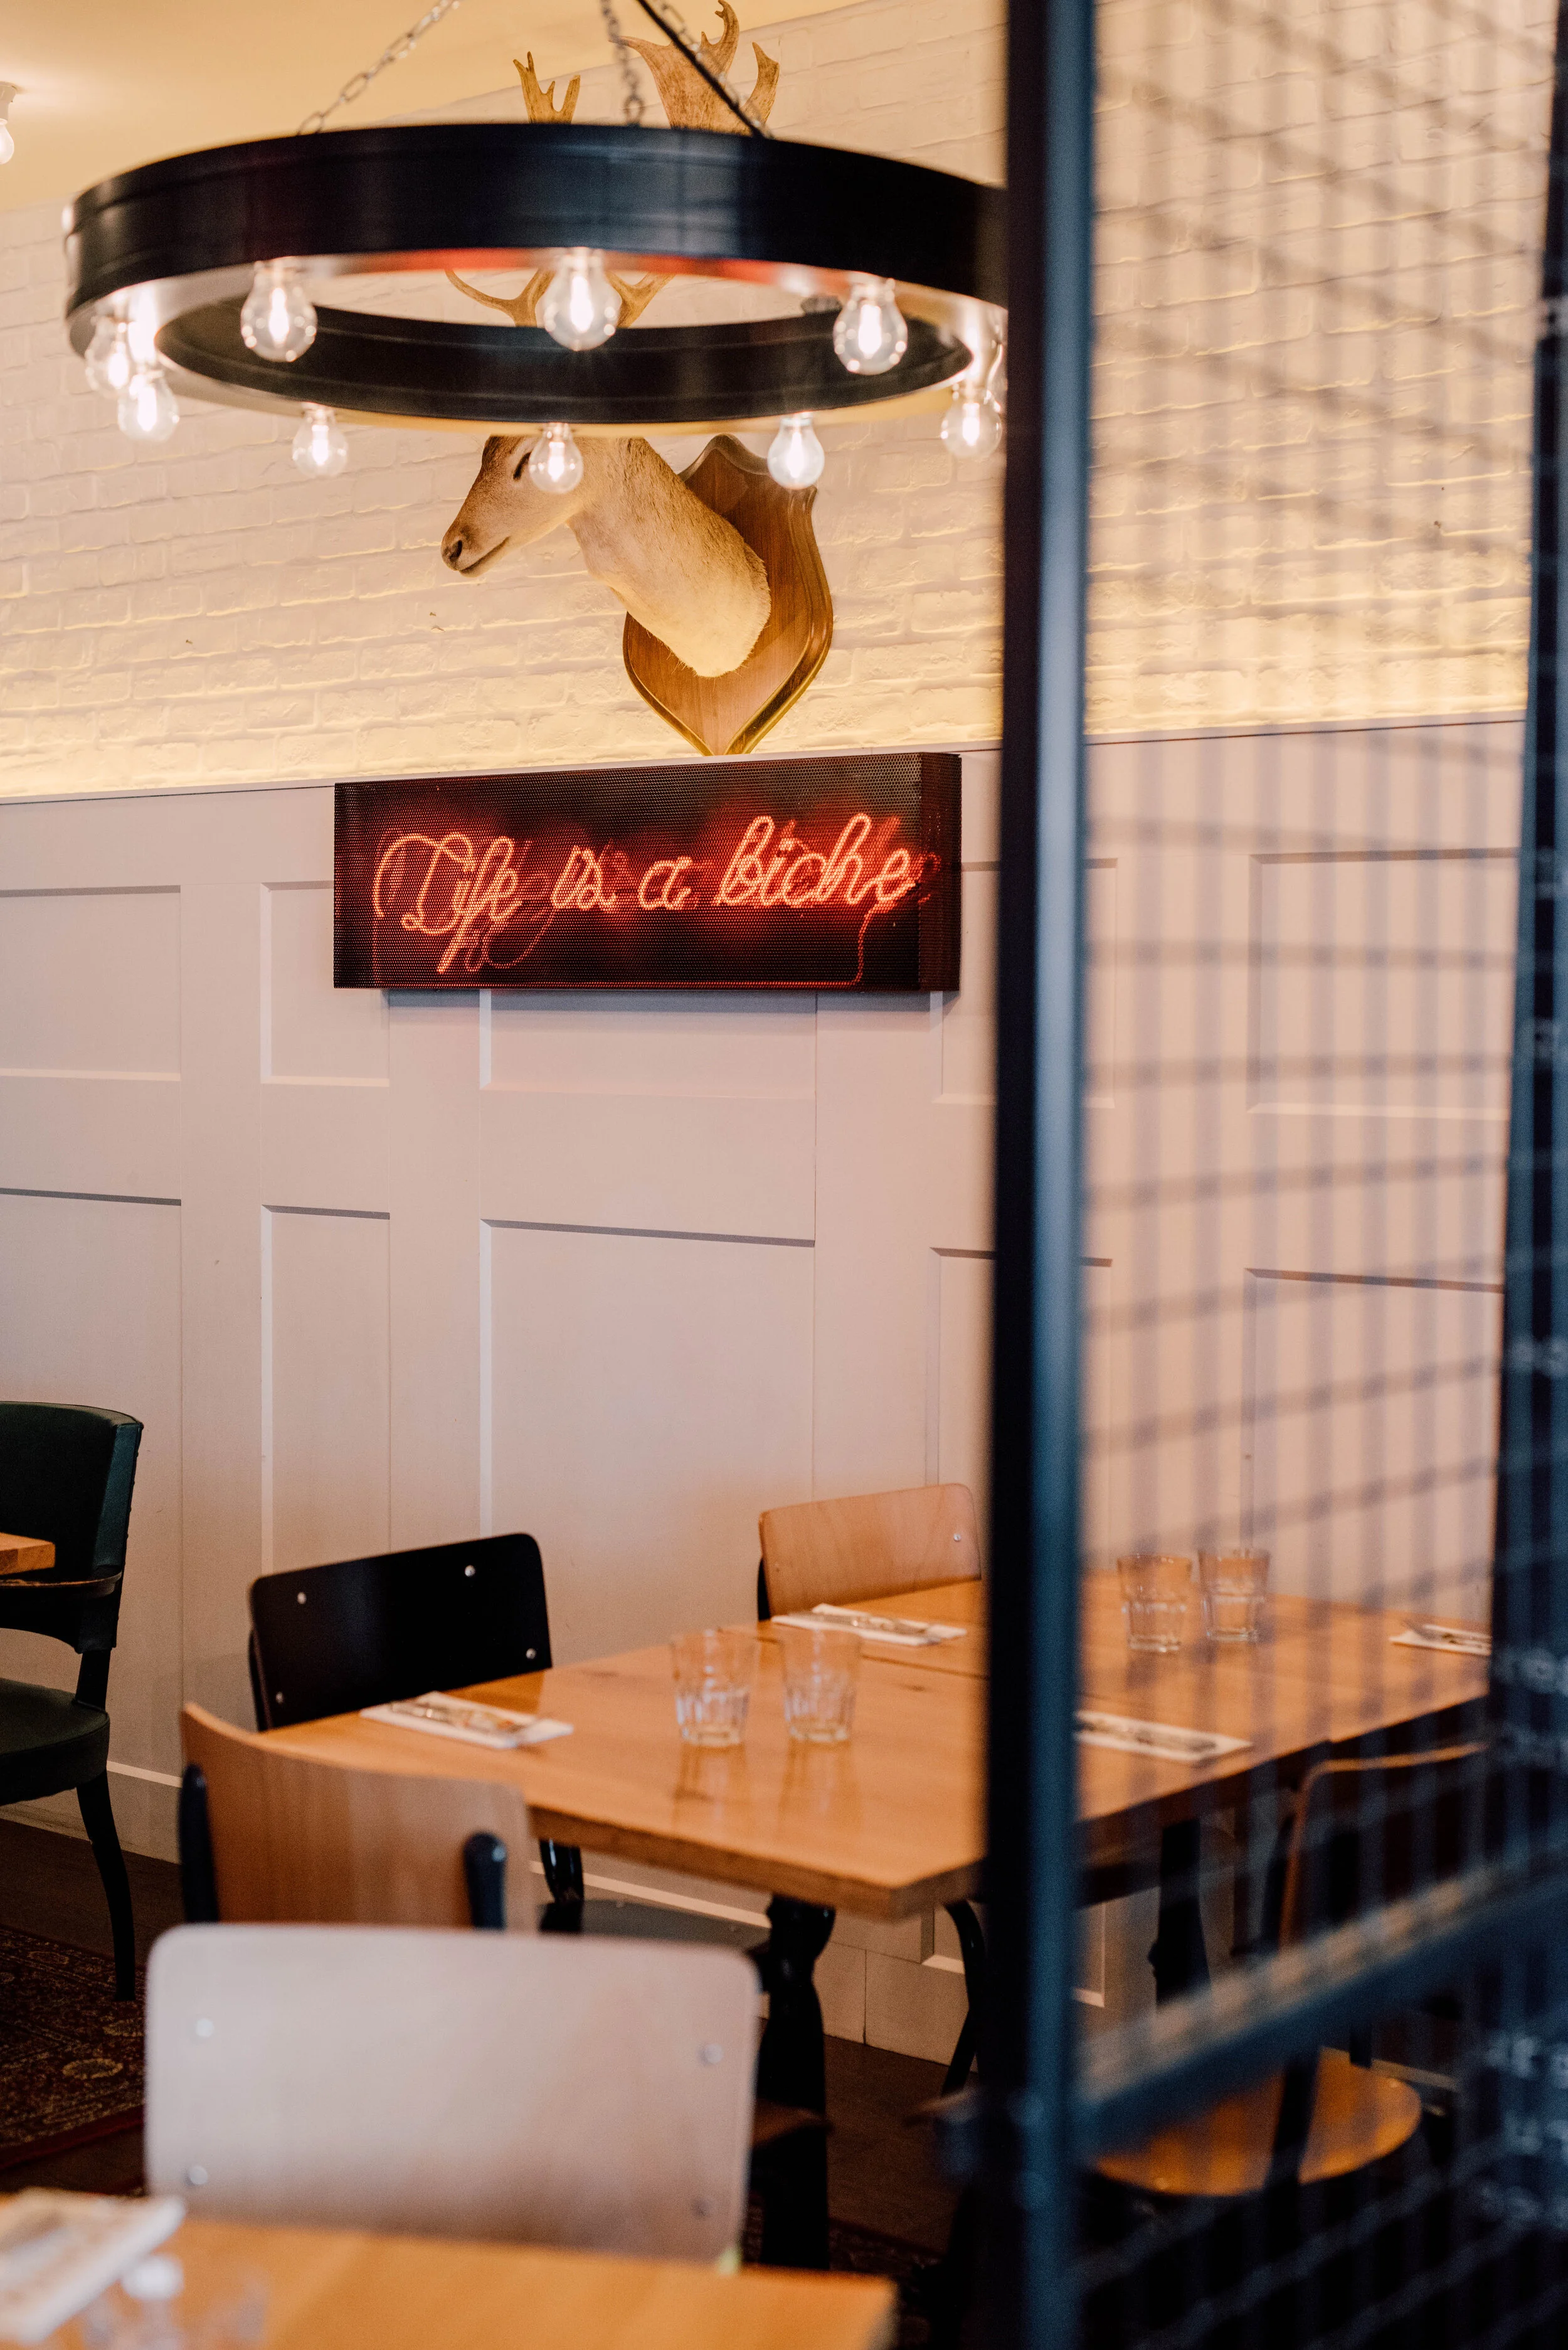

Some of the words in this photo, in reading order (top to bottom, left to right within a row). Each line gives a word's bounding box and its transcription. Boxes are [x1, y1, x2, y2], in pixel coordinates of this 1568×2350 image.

[373, 832, 522, 972] Life
[551, 845, 617, 912] is
[637, 856, 692, 910] a
[712, 813, 916, 908] biche
